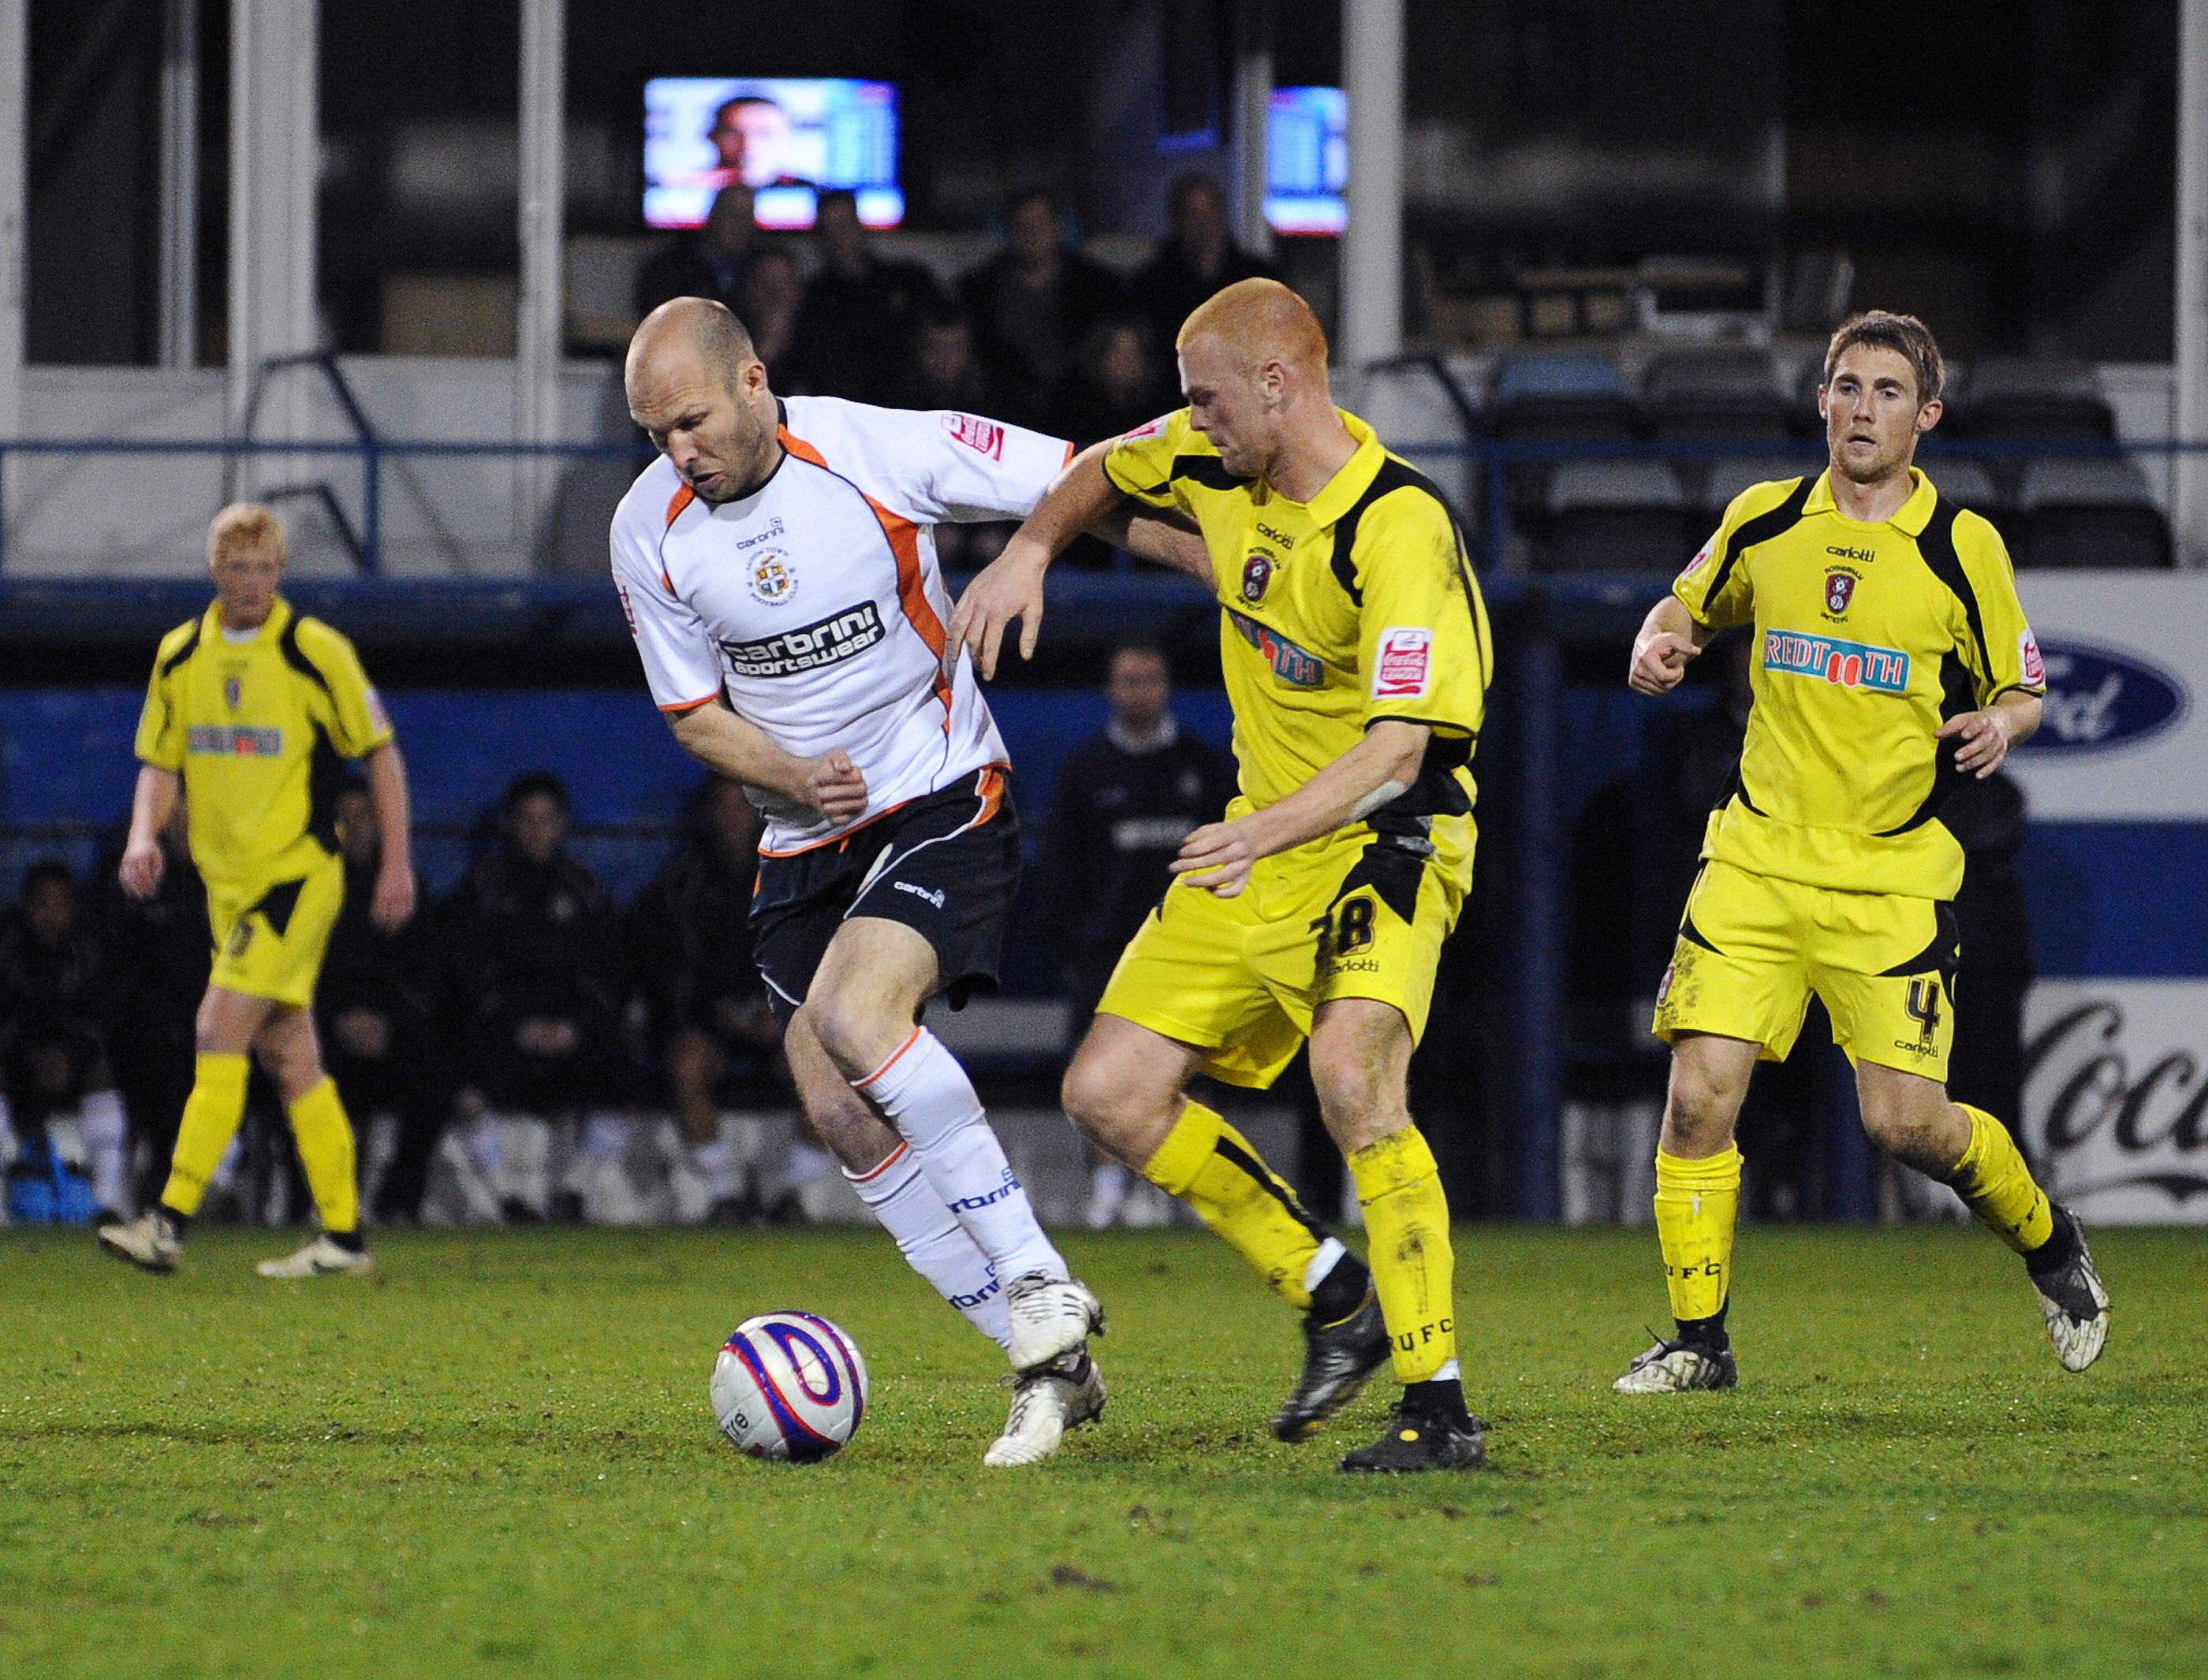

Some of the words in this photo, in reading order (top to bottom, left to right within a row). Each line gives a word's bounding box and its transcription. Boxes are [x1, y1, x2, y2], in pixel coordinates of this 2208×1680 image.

[722, 606, 875, 661] carbrini
[734, 625, 879, 676] sportswear
[1764, 635, 1904, 687] REDTOOTH
[1905, 976, 1941, 1043] 4
